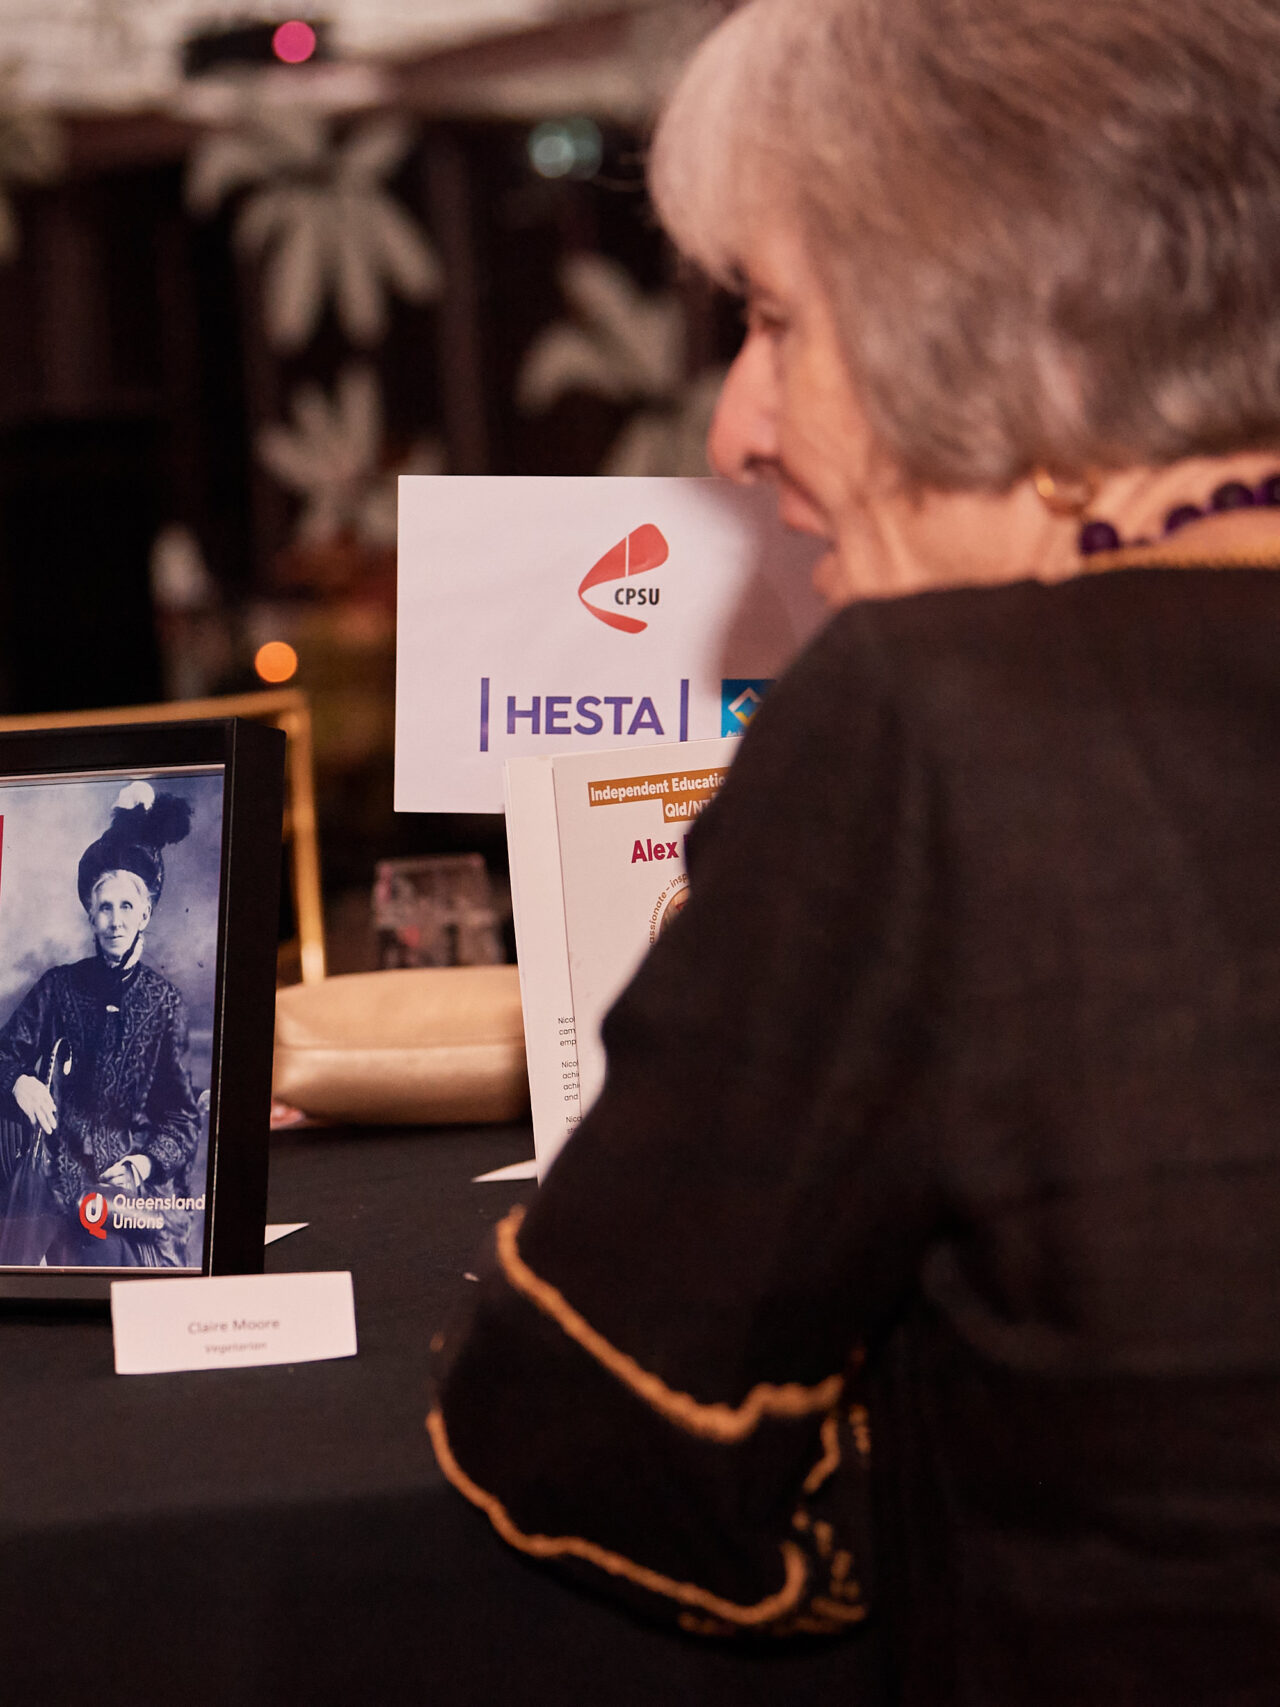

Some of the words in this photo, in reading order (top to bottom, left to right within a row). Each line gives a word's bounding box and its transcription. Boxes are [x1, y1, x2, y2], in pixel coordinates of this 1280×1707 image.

[614, 588, 661, 606] CPSU
[506, 696, 664, 735] HESTA
[590, 779, 670, 803] Independent
[631, 838, 679, 863] Alex
[648, 891, 668, 950] assionate
[112, 1193, 206, 1211] Queensland
[112, 1213, 165, 1230] Unions
[187, 1320, 228, 1335] Claire
[232, 1318, 280, 1331] Moore
